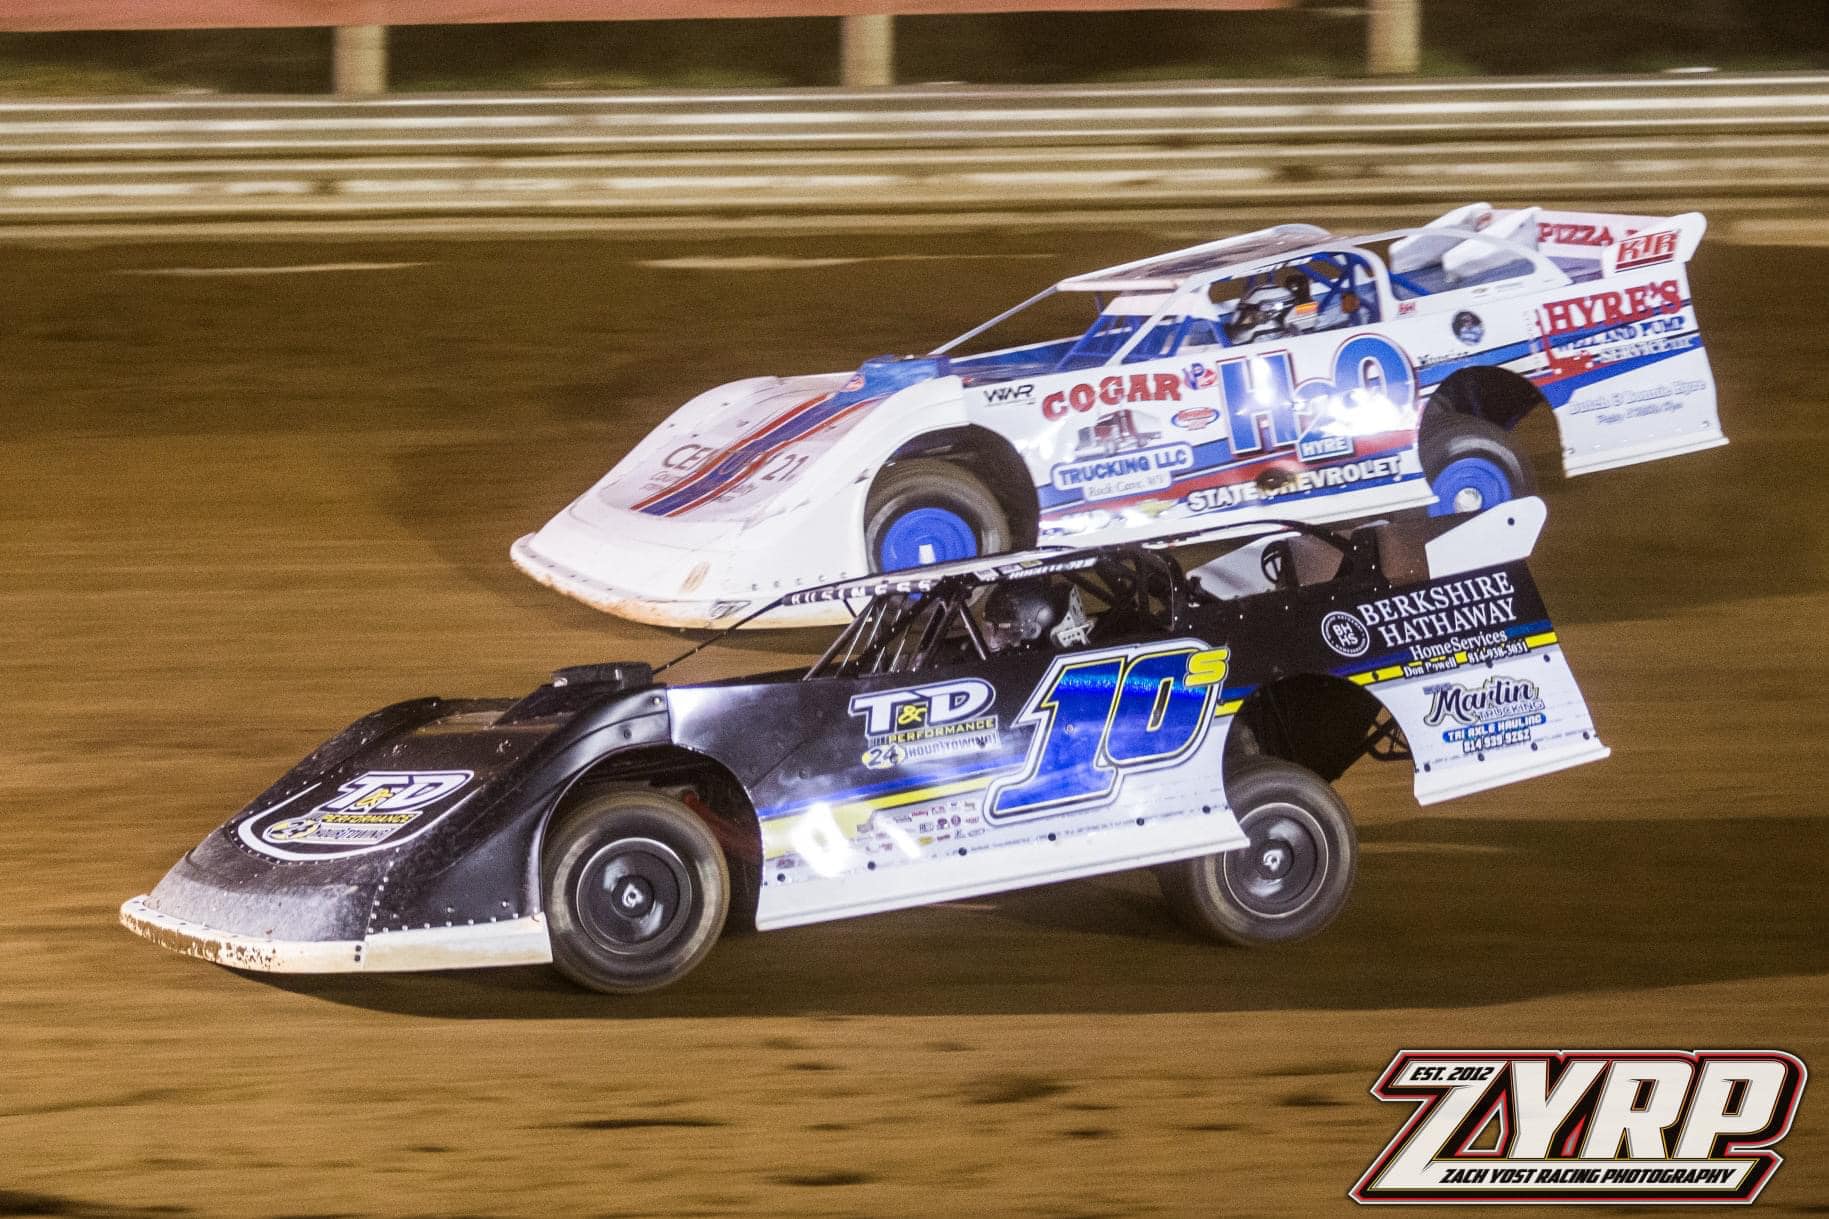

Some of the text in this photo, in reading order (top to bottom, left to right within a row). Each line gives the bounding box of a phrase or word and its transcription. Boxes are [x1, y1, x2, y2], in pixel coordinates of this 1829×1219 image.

[1537, 223, 1614, 246] PIZZA
[1543, 280, 1681, 334] HYRE'S
[1641, 315, 1686, 336] PUMP
[1042, 373, 1182, 421] COGAR
[1302, 437, 1348, 456] HYRE
[1059, 449, 1187, 486] TRUCKING LLC
[1187, 481, 1259, 512] STATE
[1357, 572, 1515, 626] BERKSHIRE
[1378, 597, 1517, 647] HATHAWAY
[1409, 630, 1508, 660] HomeServices
[1404, 664, 1424, 678] Don
[1425, 656, 1456, 672] Powell
[850, 680, 994, 735] T&D
[1430, 680, 1534, 723] Martin
[889, 719, 994, 744] PERFORMANCE
[868, 745, 901, 766] 24
[908, 742, 943, 758] HOUR
